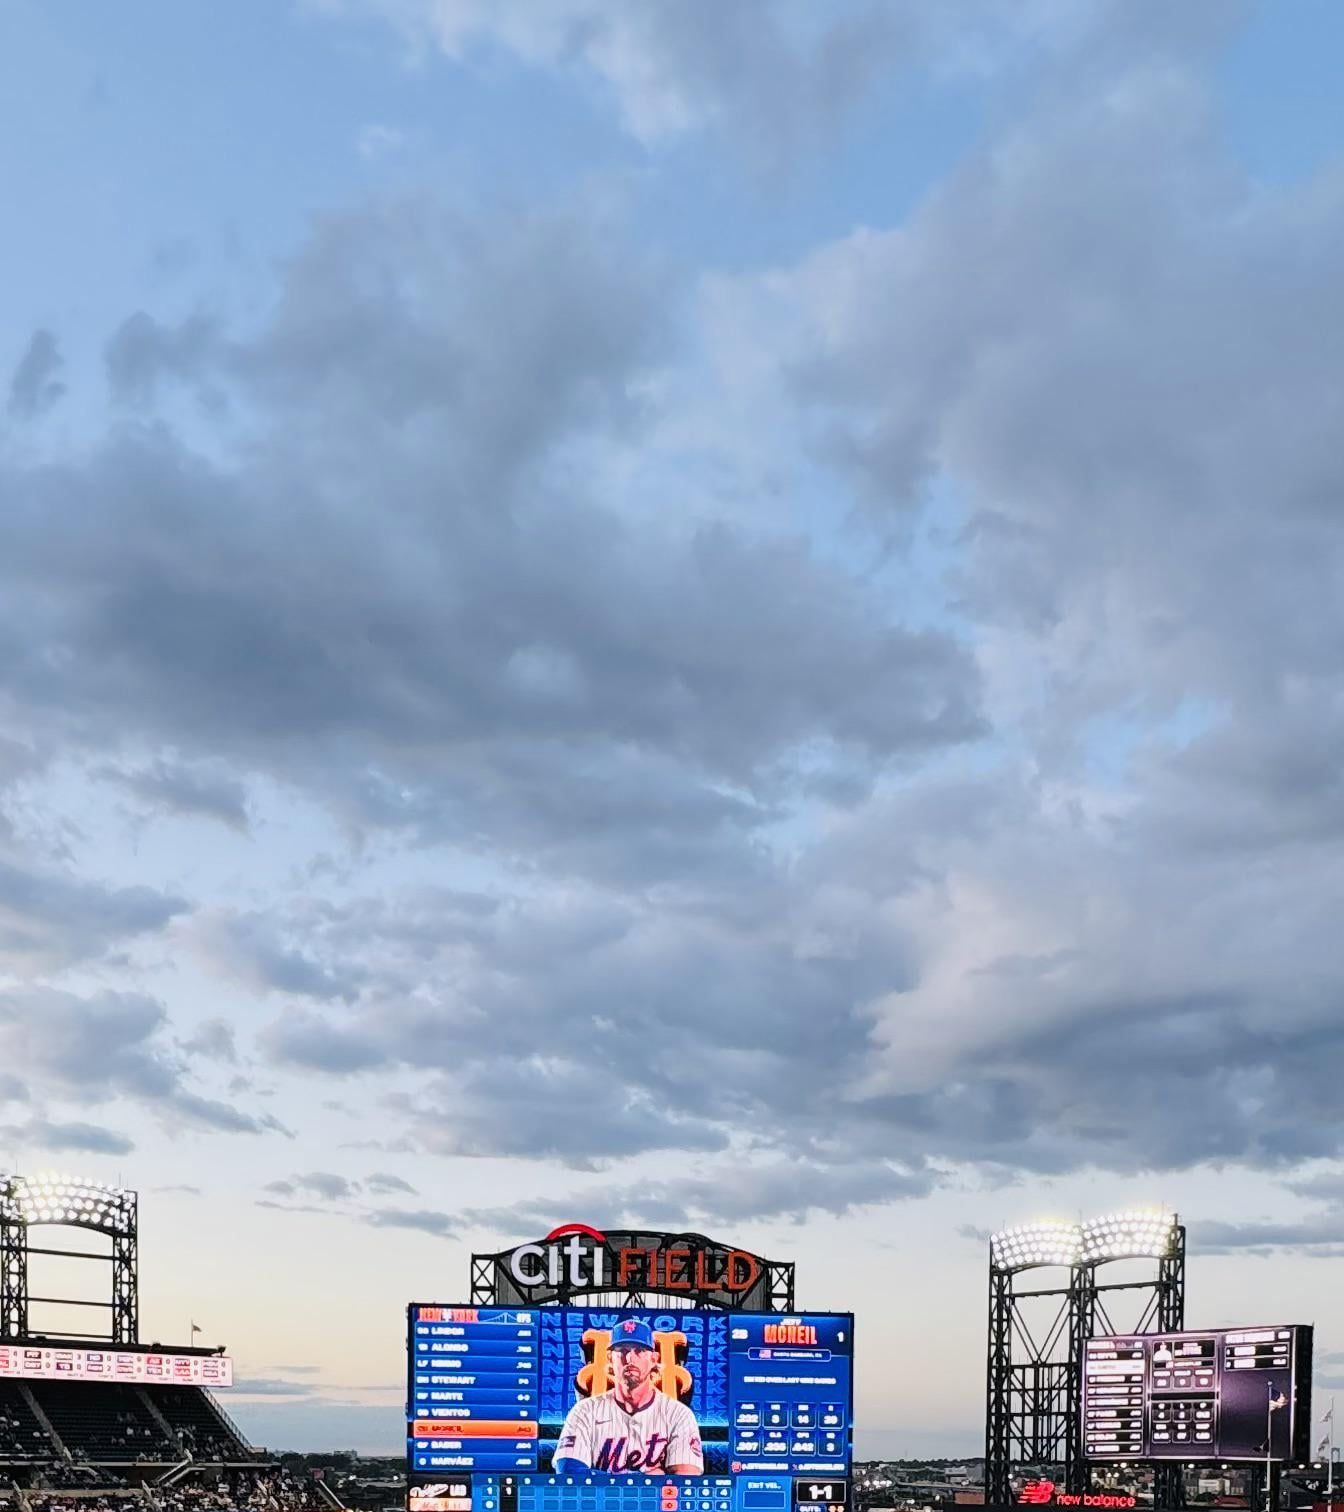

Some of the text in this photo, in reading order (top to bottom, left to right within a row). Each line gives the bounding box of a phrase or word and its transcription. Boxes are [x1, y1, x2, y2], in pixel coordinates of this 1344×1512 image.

[511, 1232, 758, 1291] citi FIELD
[542, 1313, 619, 1328] NEW
[837, 1332, 844, 1342] 1
[809, 1485, 832, 1499] 1-1
[1056, 1494, 1136, 1507] new balance
